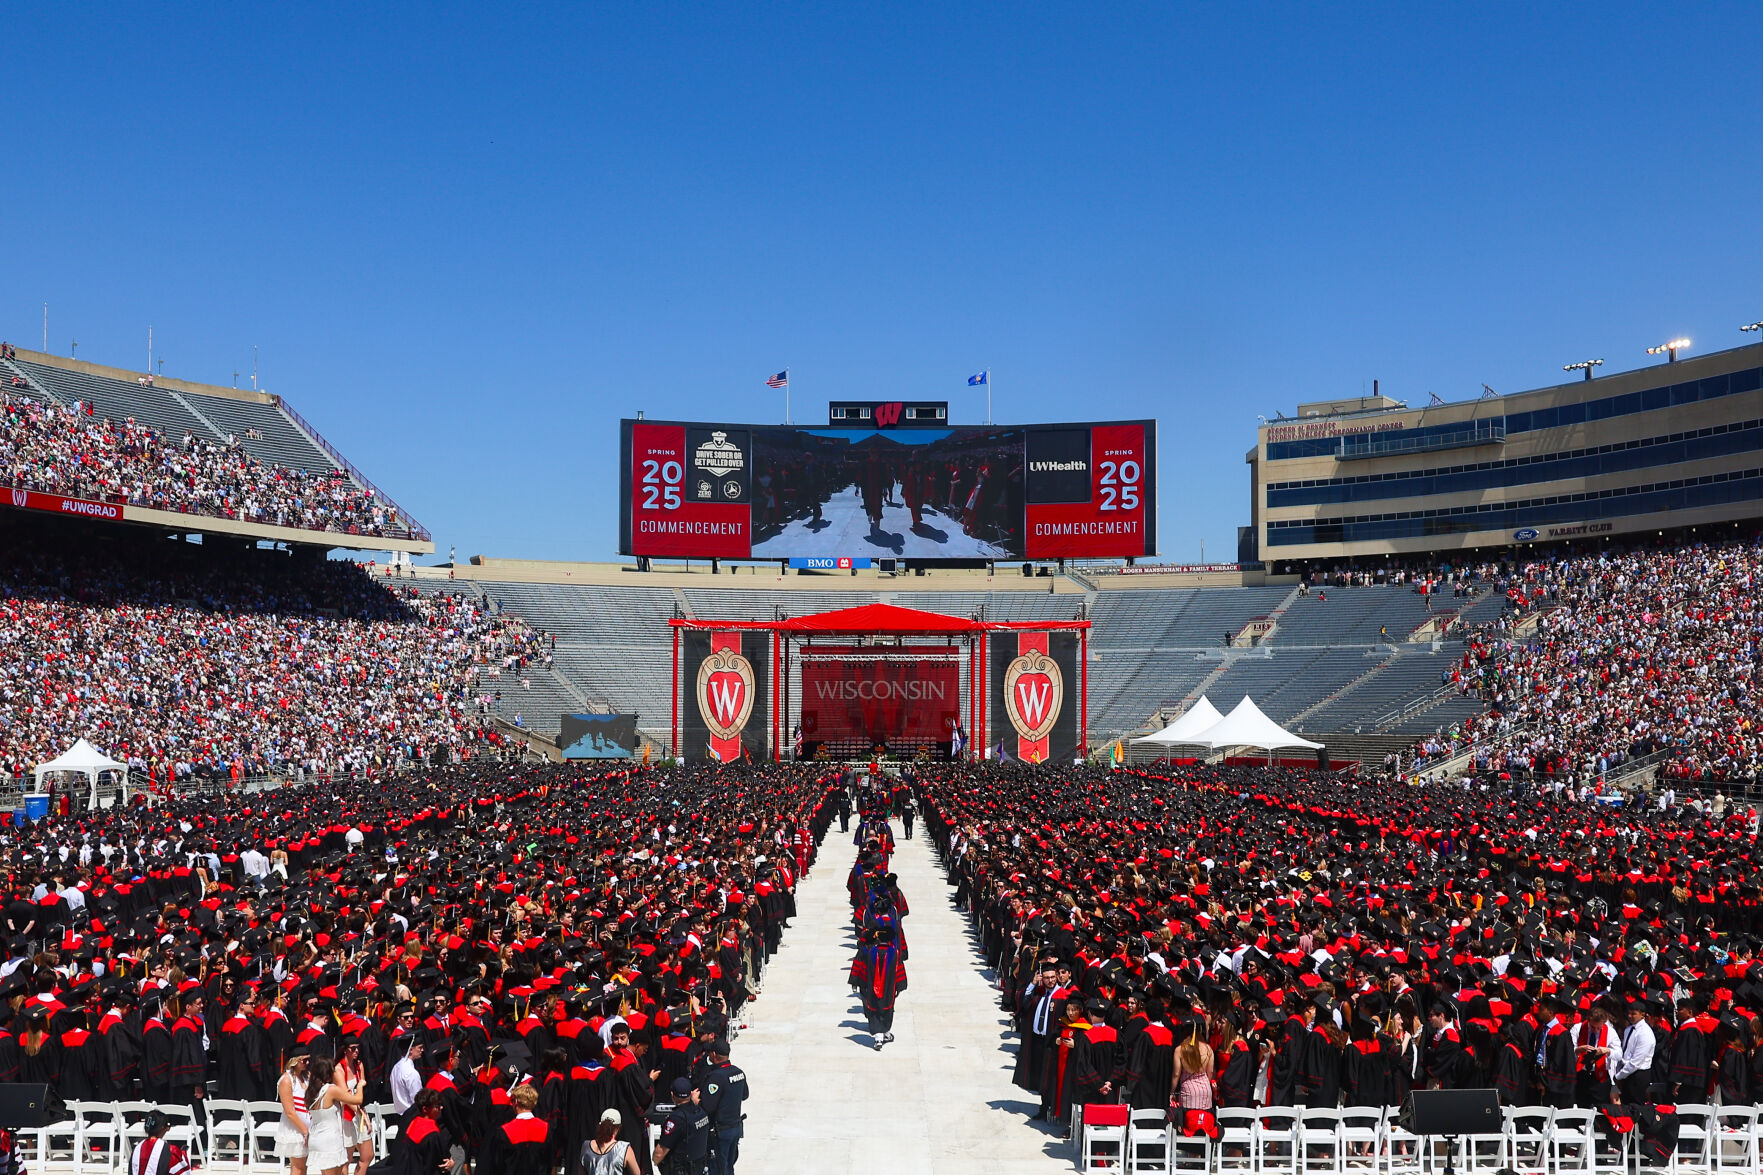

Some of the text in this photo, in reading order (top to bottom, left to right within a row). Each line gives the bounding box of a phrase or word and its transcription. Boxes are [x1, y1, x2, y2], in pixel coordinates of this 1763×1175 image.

[1329, 424, 1376, 435] PERFORMANCE
[1378, 421, 1403, 430] CENTER
[642, 459, 682, 484] 20
[695, 458, 706, 466] GET
[1100, 460, 1140, 485] 20
[642, 485, 682, 510] 25
[1100, 485, 1139, 511] 25
[62, 499, 117, 517] #UWGRAD
[640, 520, 743, 535] COMMENCEMENT
[1035, 521, 1138, 536] COMMENCEMENT
[1548, 523, 1613, 536] VARSITY CLUB
[808, 558, 834, 568] BMO
[814, 680, 945, 700] WISCONSIN
[710, 679, 742, 722] W
[1017, 680, 1050, 723] W
